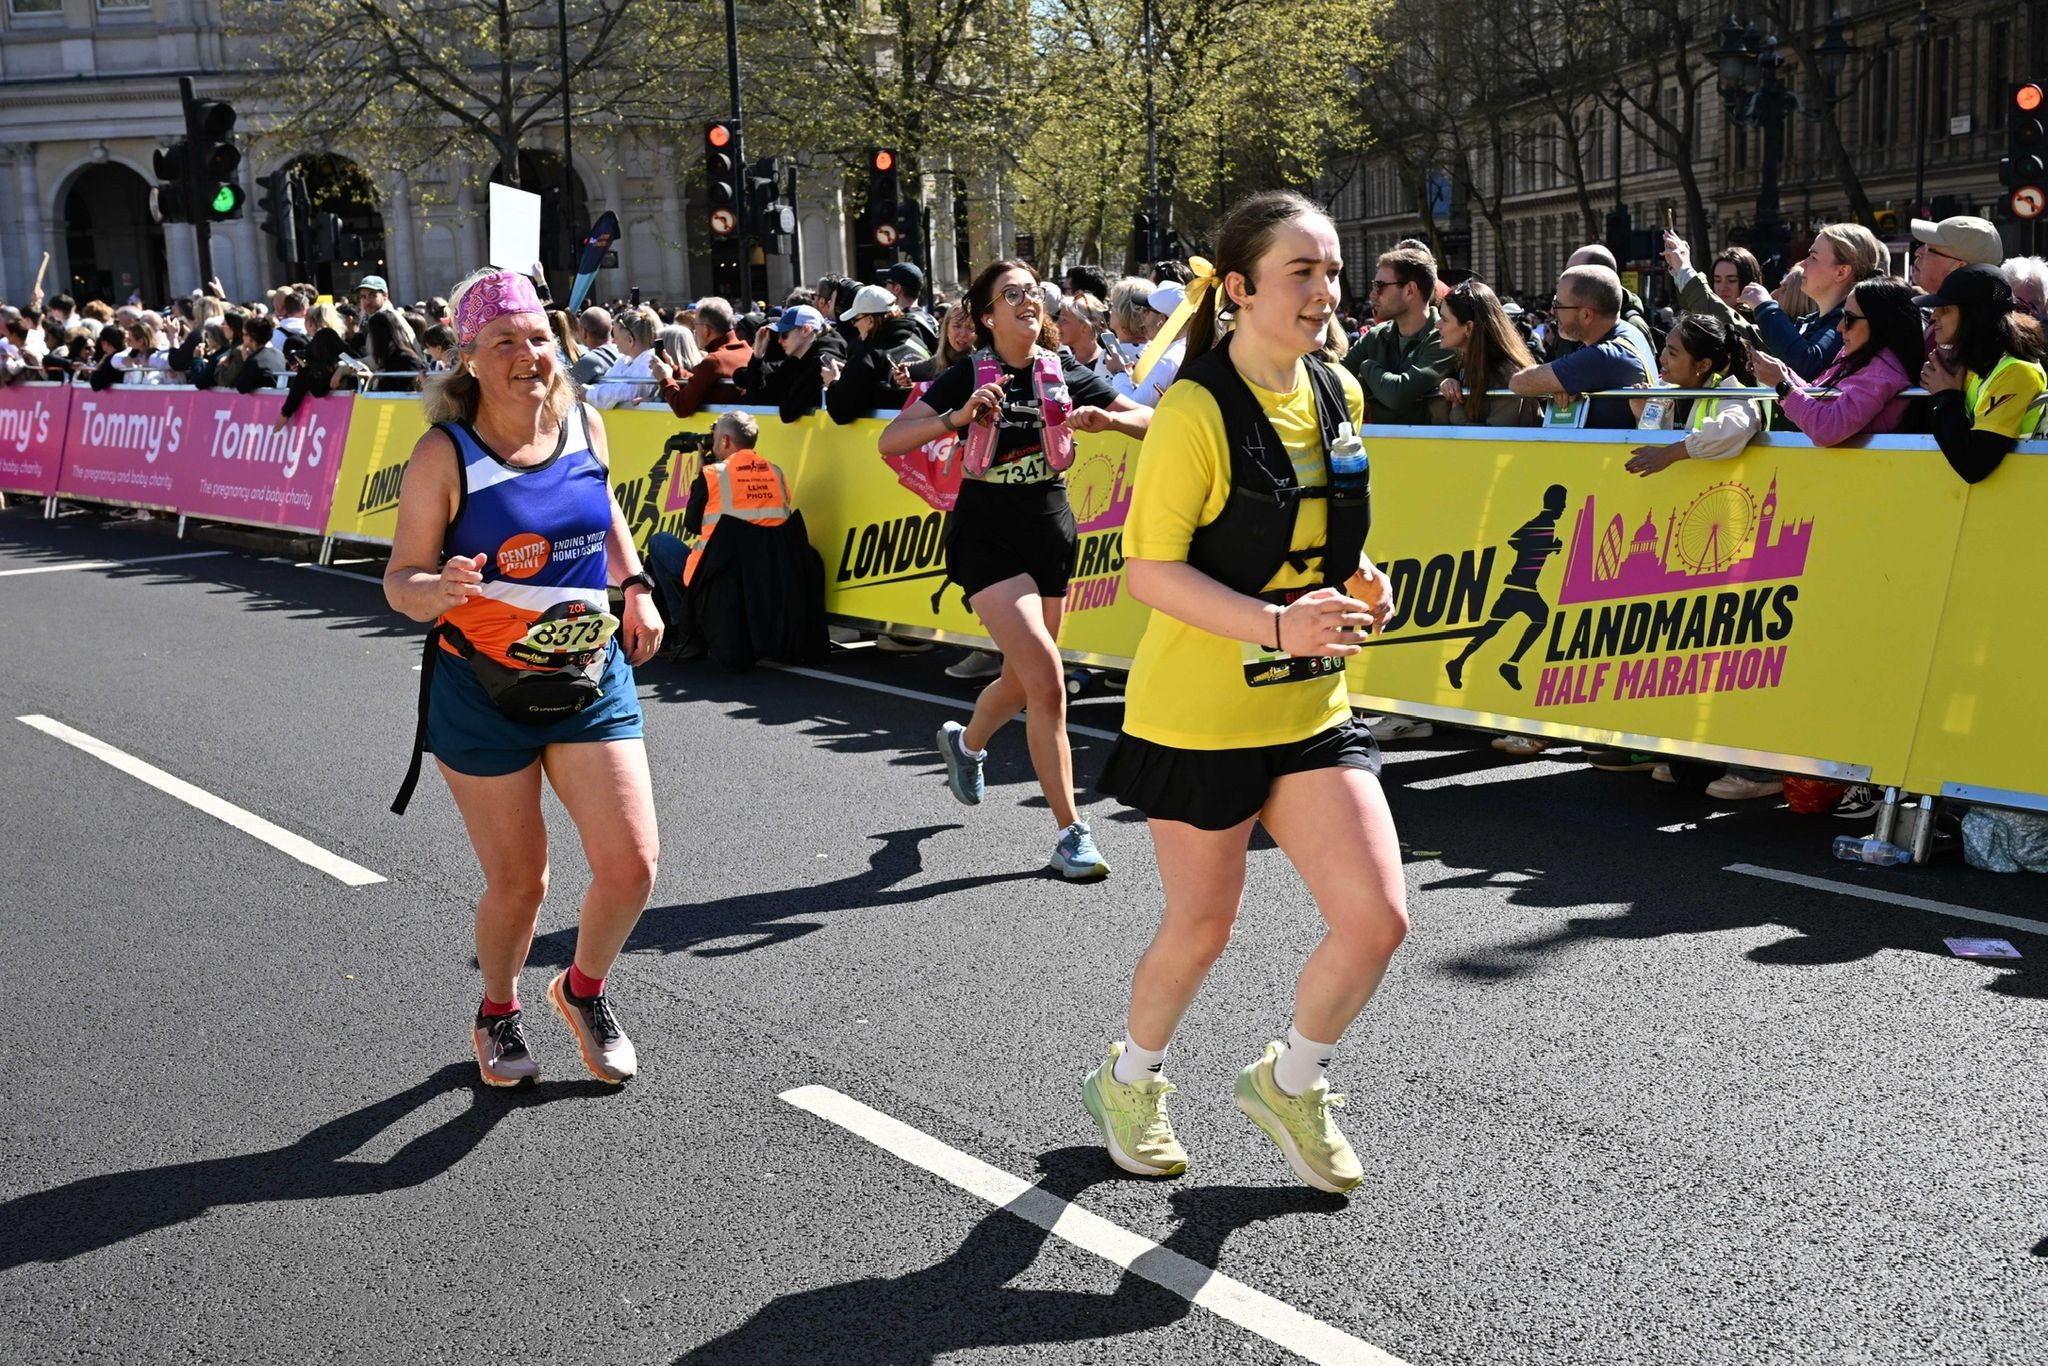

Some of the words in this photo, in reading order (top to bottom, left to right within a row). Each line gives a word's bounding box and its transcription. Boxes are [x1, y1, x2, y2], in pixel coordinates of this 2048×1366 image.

[0, 401, 50, 452] my's
[81, 402, 182, 464] Tommy's
[211, 409, 326, 479] Tommy's
[72, 464, 83, 478] The
[84, 468, 116, 484] pregnancy
[117, 468, 130, 483] and
[131, 469, 148, 488] baby
[149, 471, 173, 491] charity
[997, 457, 1047, 485] 7347
[200, 479, 212, 494] The
[212, 484, 246, 502] pregnancy
[250, 486, 265, 500] and
[265, 485, 285, 506] baby
[285, 488, 313, 510] charity
[746, 492, 774, 500] PHOTO
[500, 541, 546, 565] CENTRE
[553, 536, 584, 551] ENDING
[568, 603, 586, 614] ZOE
[533, 620, 604, 646] 8373
[1545, 584, 1799, 663] LANDMARKS
[1534, 662, 1611, 707] HALF
[1613, 645, 1788, 701] MARATHON
